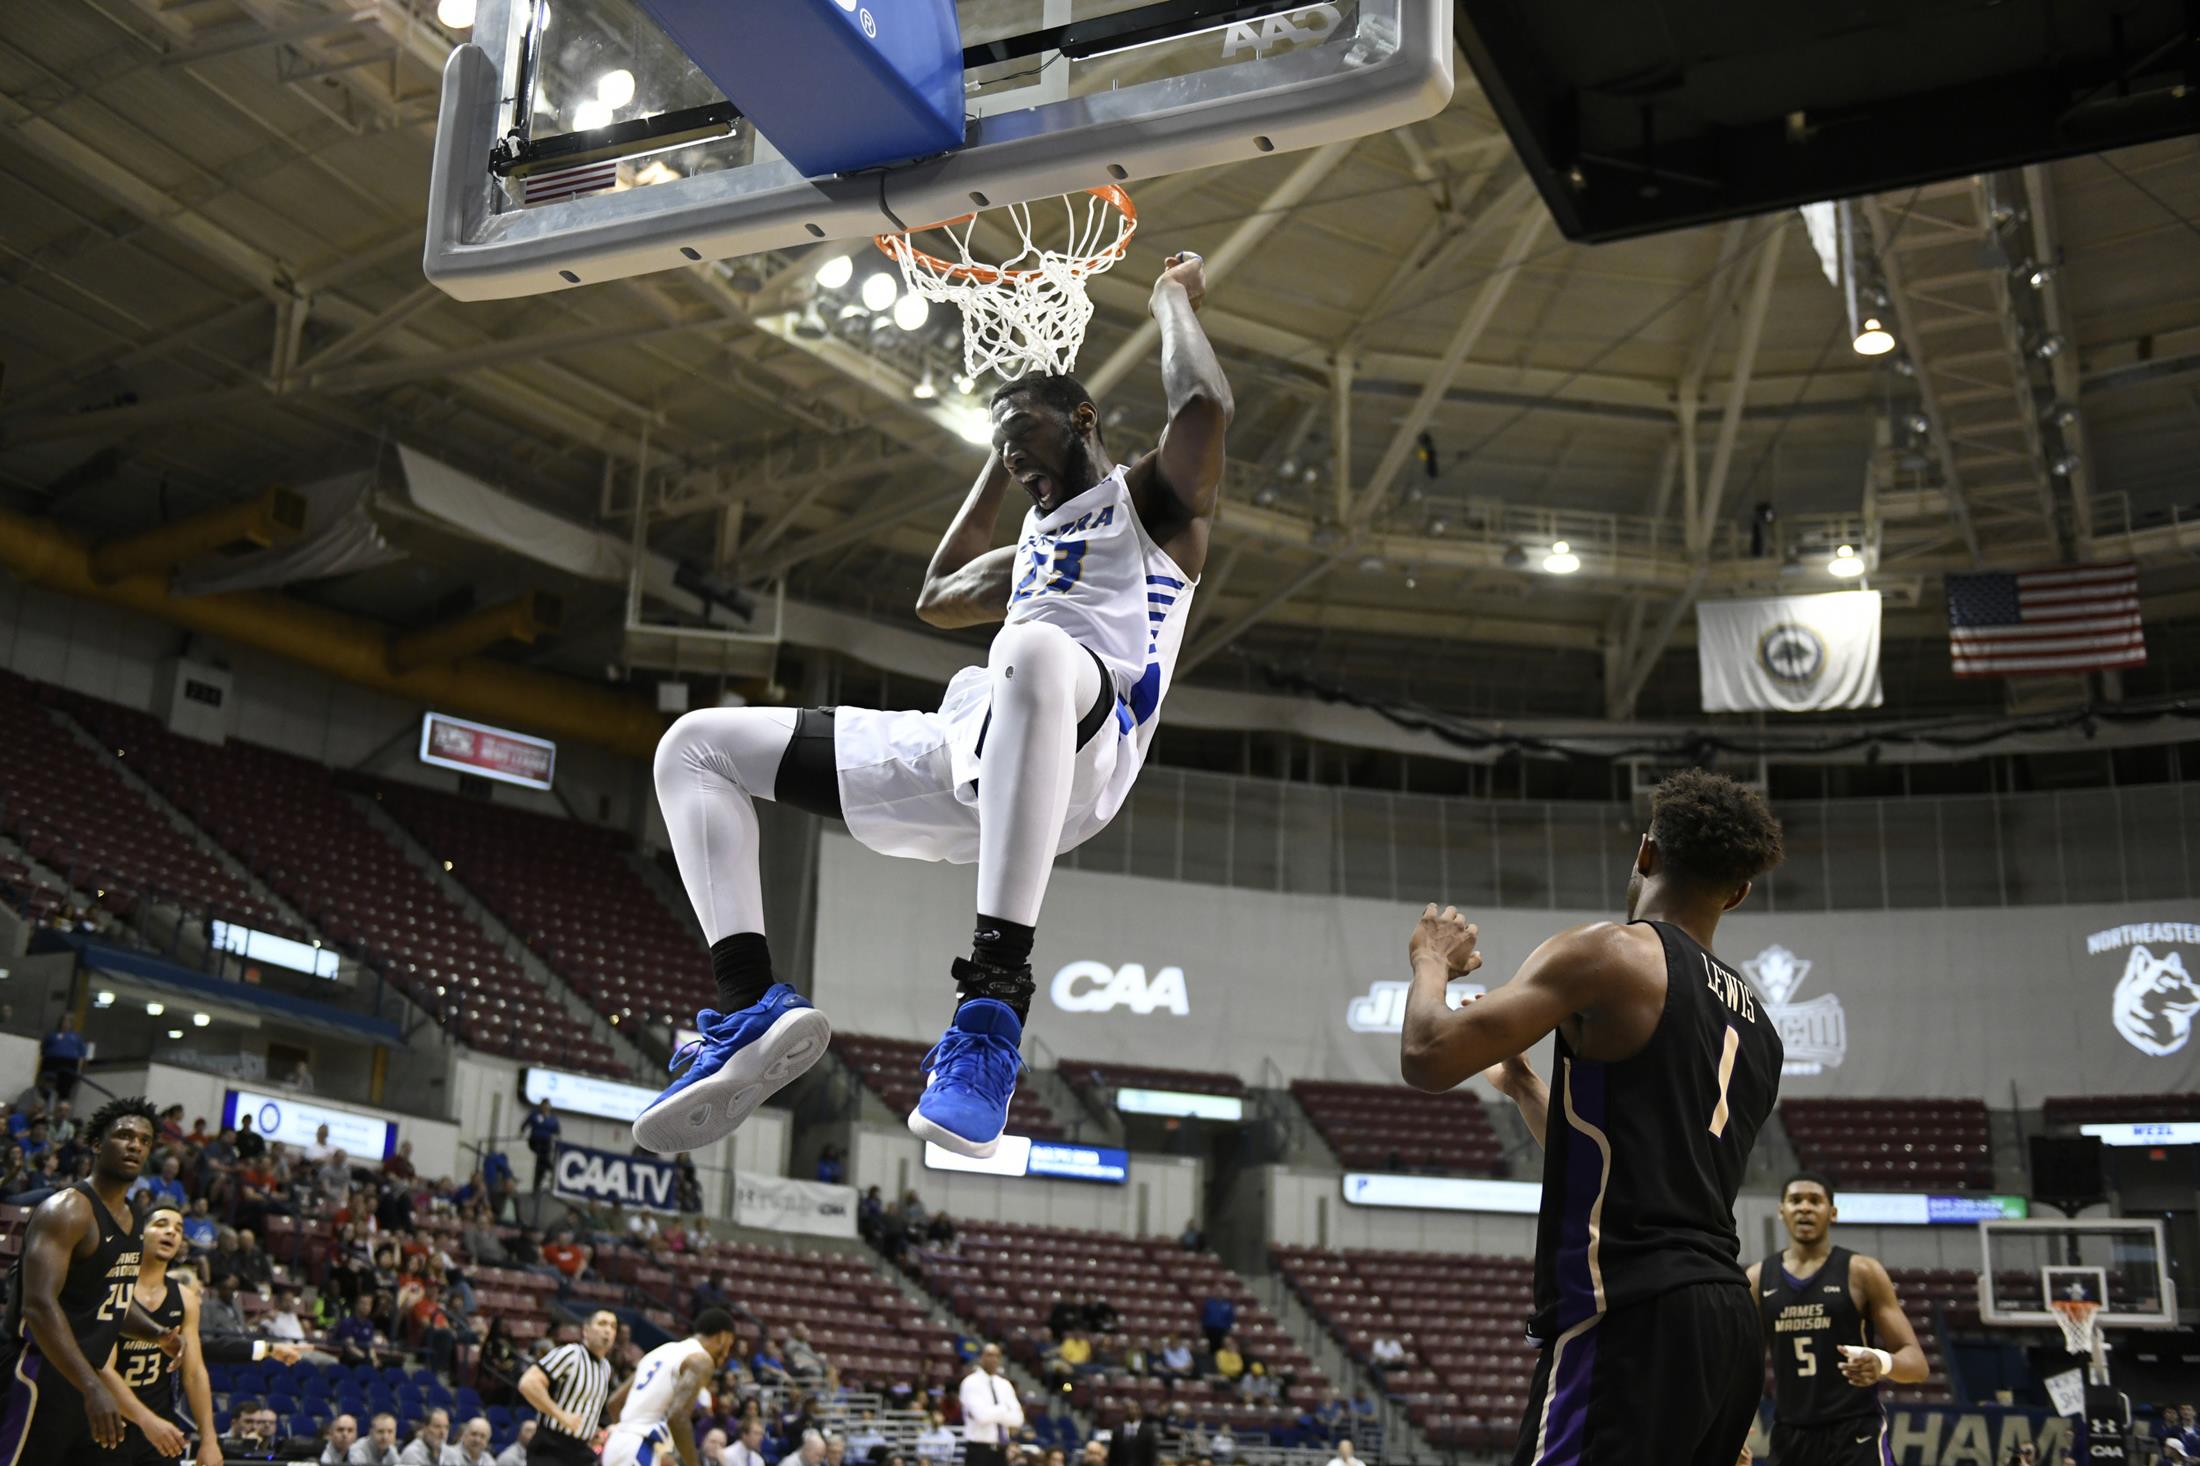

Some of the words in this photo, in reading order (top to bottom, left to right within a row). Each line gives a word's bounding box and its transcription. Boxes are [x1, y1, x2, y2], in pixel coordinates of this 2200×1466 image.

[1050, 960, 1191, 1017] CAA
[1700, 951, 1757, 1025] LEWIS
[1708, 1023, 1741, 1140] 1
[559, 1149, 673, 1206] CAA.TV
[96, 1283, 134, 1321] 24
[1780, 1303, 1825, 1319] JAMES
[1774, 1316, 1832, 1333] MADISON
[124, 1353, 161, 1388] 23
[635, 1360, 663, 1391] 3
[1793, 1336, 1817, 1378] 5
